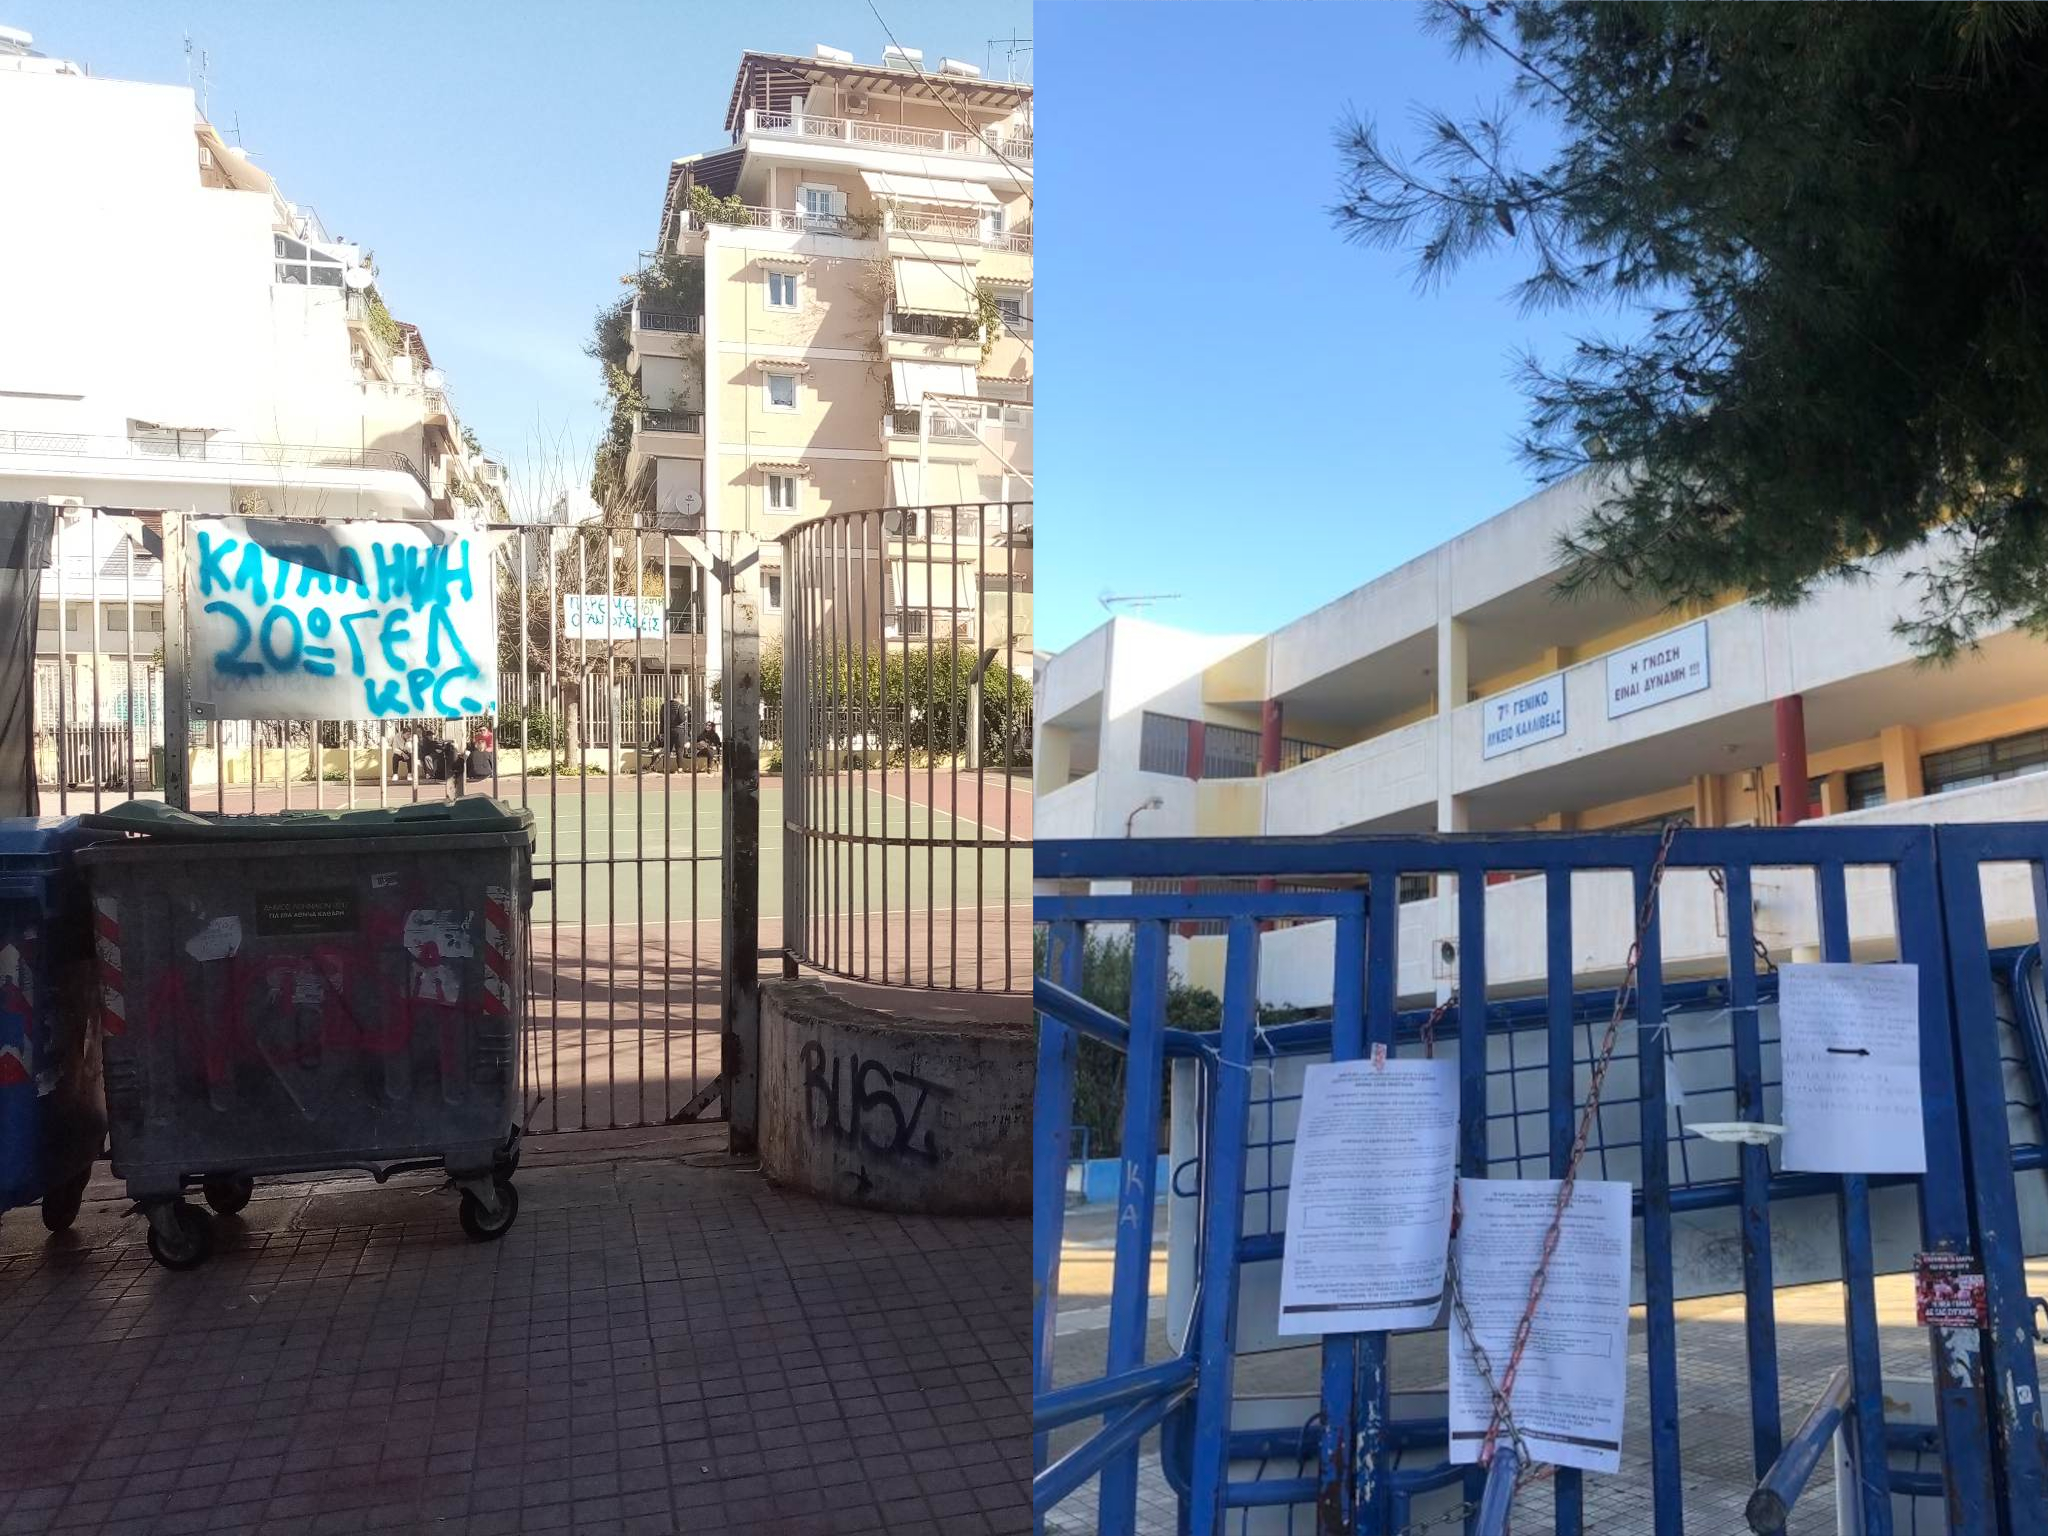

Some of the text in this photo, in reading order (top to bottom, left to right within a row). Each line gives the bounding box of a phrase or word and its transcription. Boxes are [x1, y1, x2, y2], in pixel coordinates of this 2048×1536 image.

[1631, 646, 1680, 674] Η ΓΝΩΣΗ
[1615, 682, 1640, 701] ΕΙΝΑΙ
[1644, 667, 1686, 692] ΔΥΝΑΜΗ
[1514, 690, 1549, 715] ΓΕΝΙΚΟ
[1516, 709, 1561, 738] ΚΑΛΛΙΘΕΑΣ
